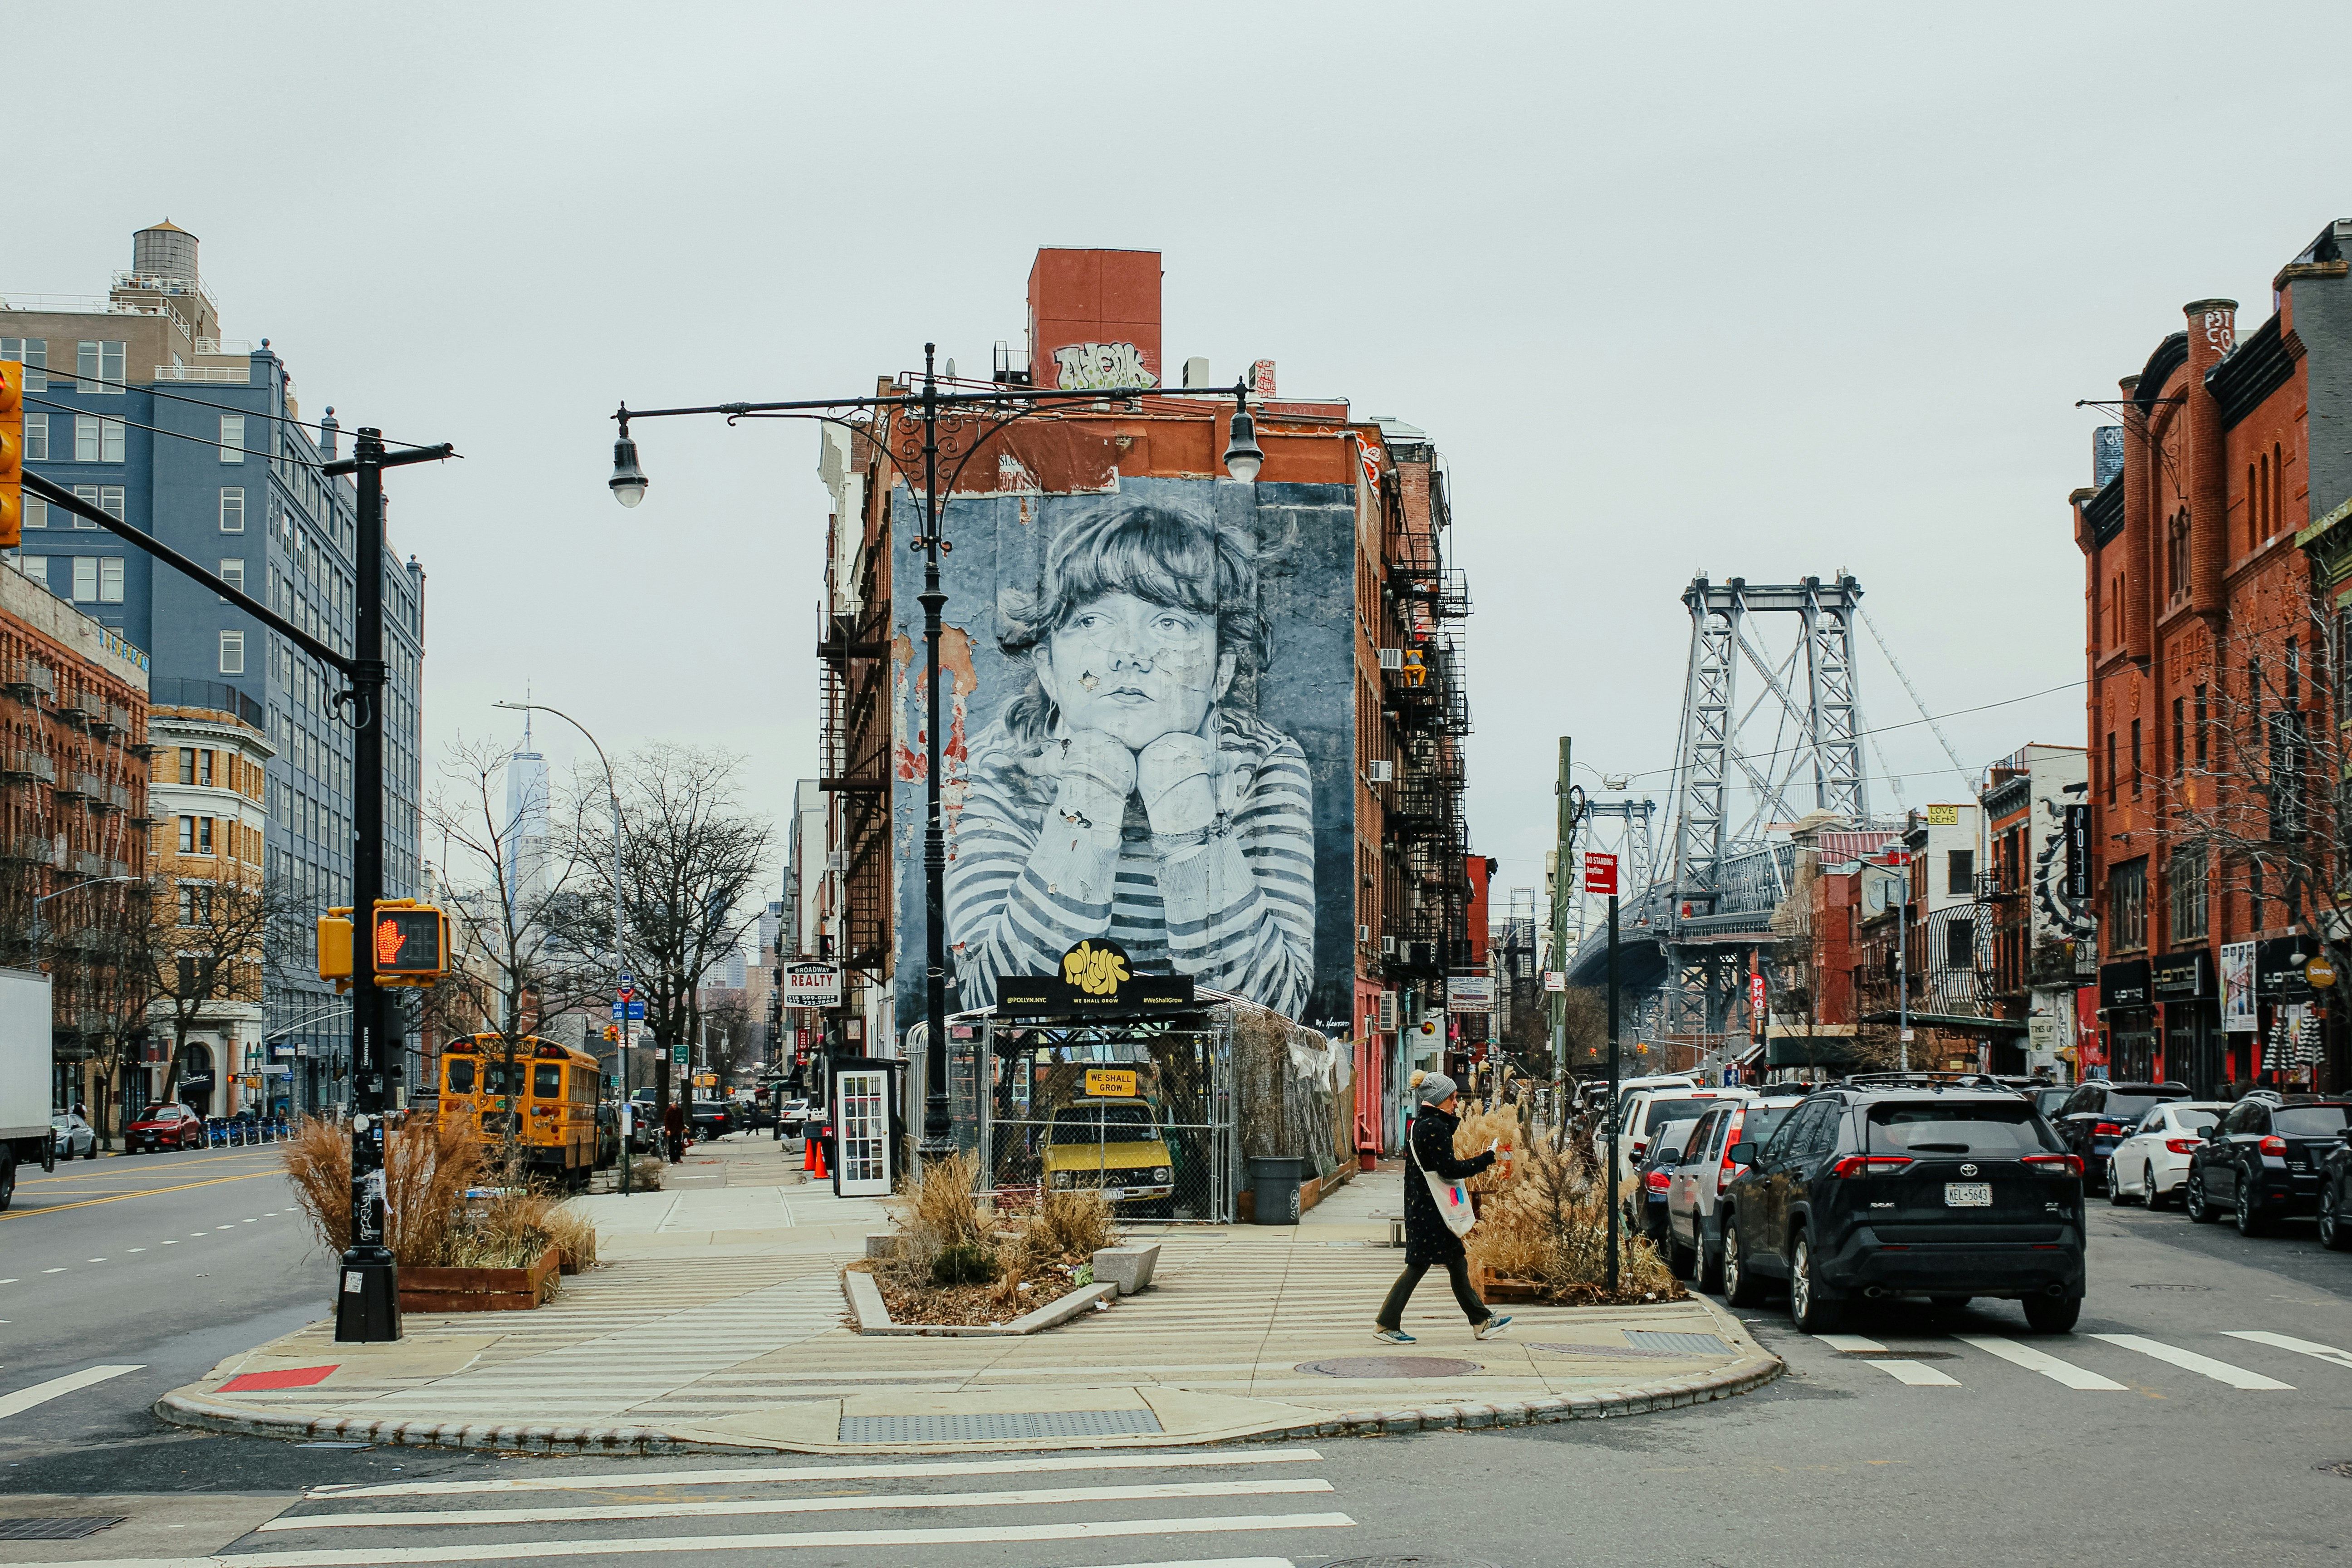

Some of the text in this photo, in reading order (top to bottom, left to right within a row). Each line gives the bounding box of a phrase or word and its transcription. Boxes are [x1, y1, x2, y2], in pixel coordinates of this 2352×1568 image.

[1586, 856, 1613, 866] NO STANDING
[1587, 866, 1604, 875] Anytime
[791, 975, 833, 986] REALTY
[1105, 1074, 1132, 1083] SHALL
[1969, 1189, 1987, 1200] 5643
